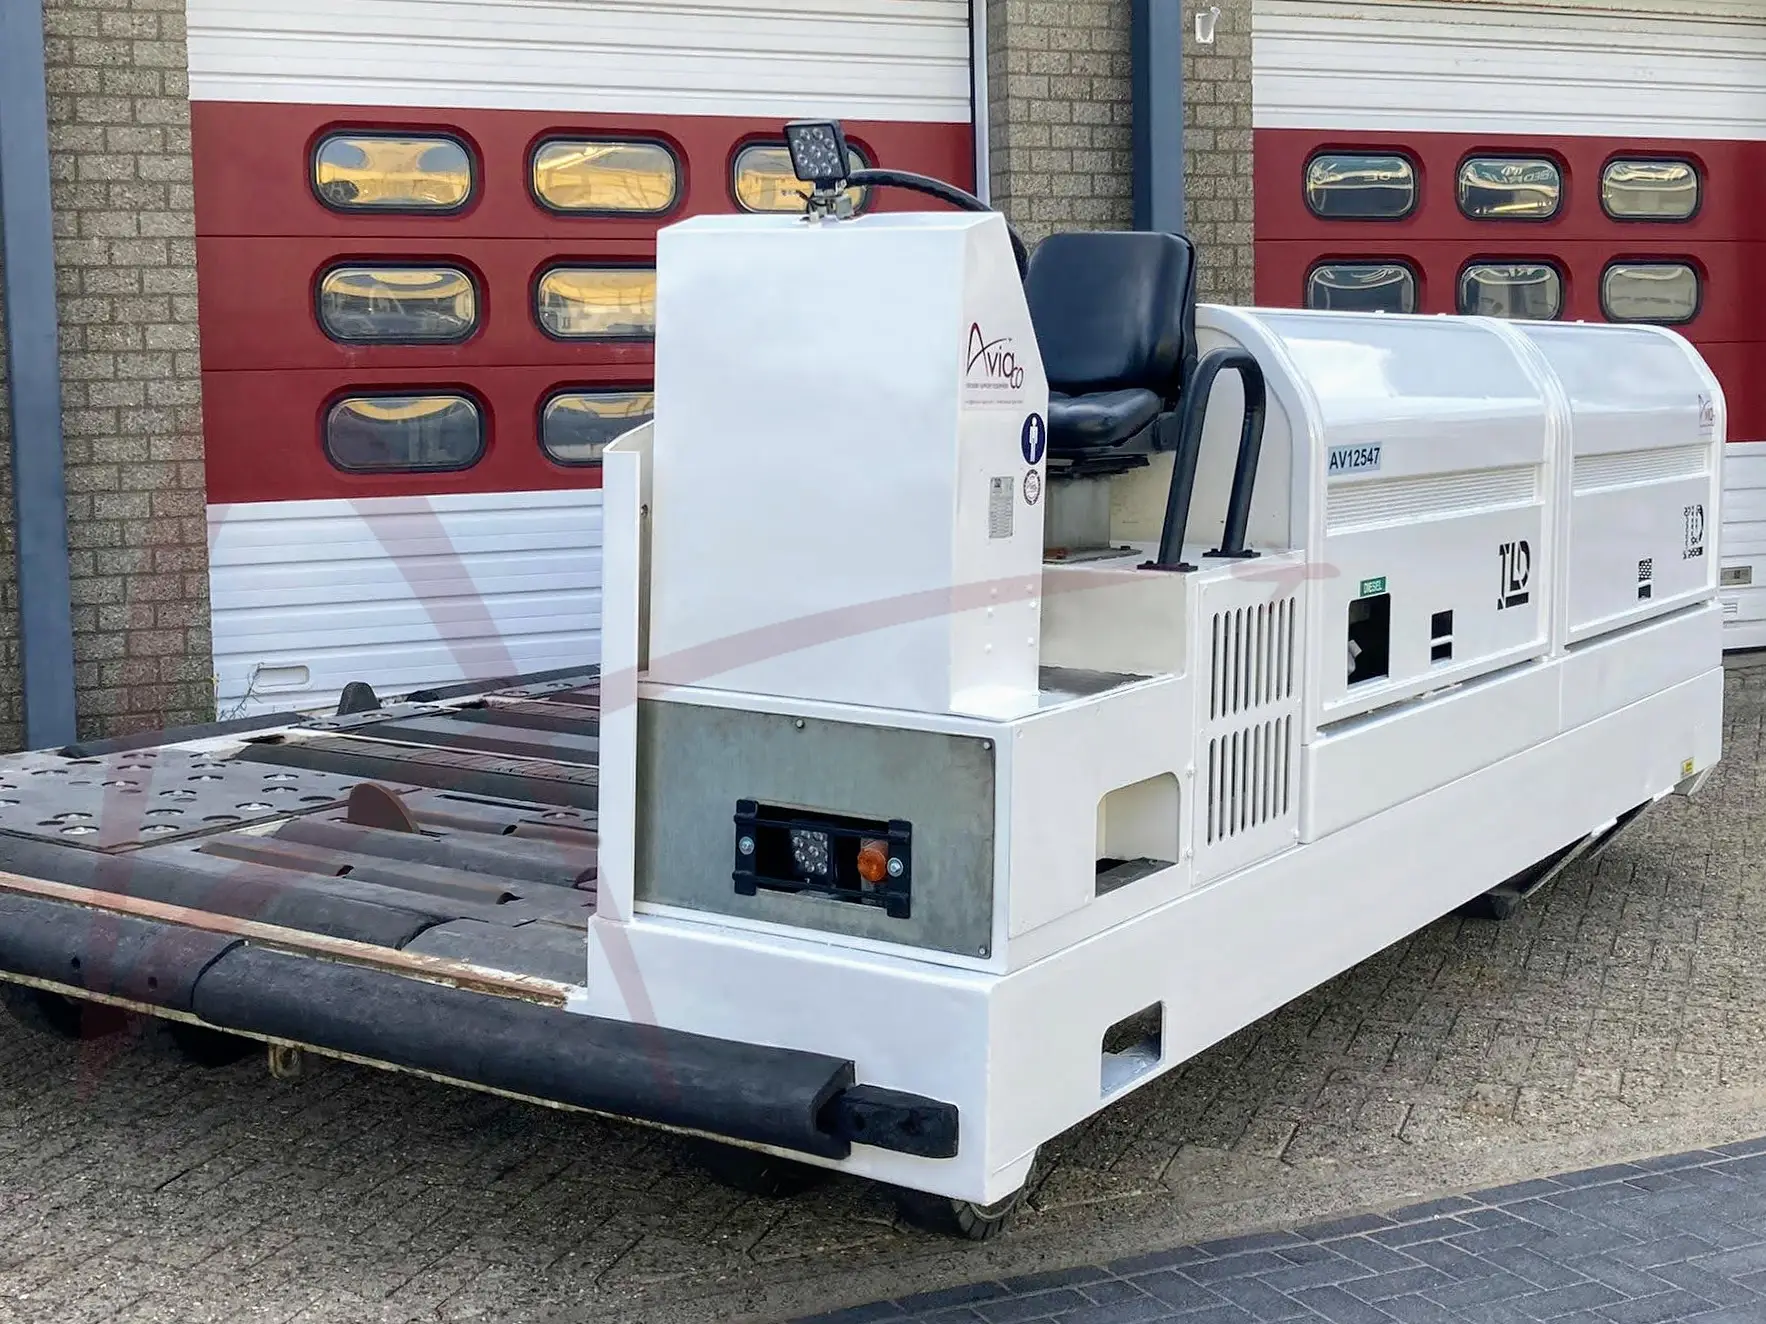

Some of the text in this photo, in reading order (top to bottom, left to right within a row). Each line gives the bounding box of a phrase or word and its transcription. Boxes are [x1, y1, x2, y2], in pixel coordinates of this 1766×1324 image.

[1329, 447, 1380, 470] AV12547
[1363, 579, 1385, 594] DIESEL
[1497, 540, 1531, 610] TLD
